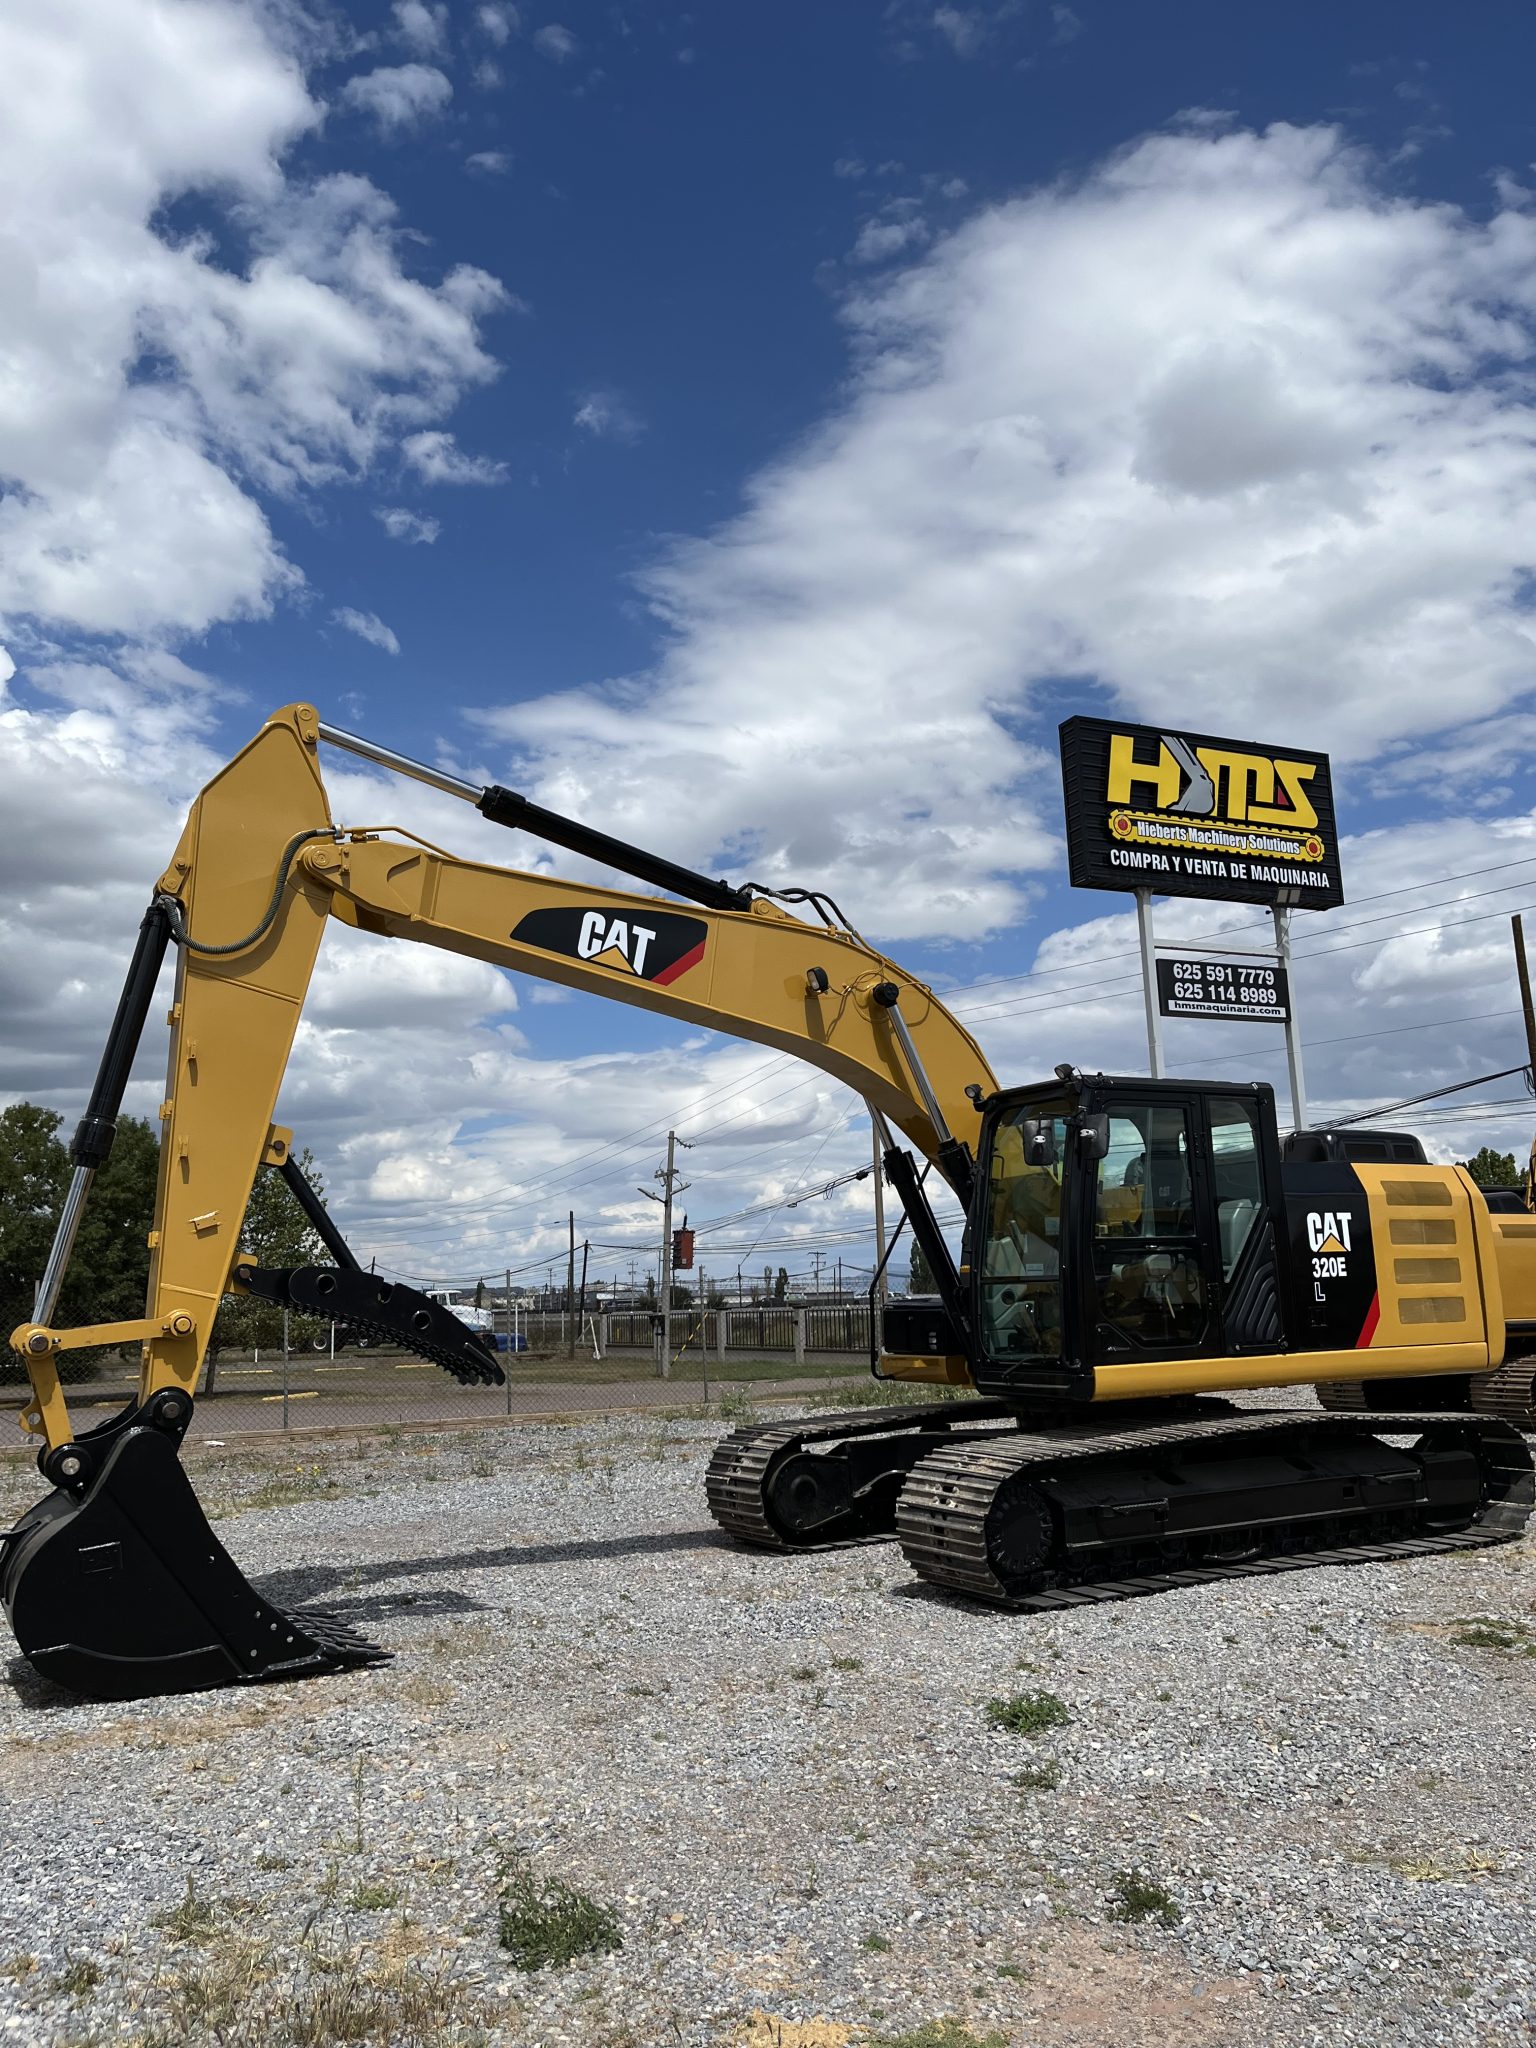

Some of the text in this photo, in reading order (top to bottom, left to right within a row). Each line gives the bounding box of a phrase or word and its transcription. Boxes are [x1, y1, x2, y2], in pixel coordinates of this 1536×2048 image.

[1137, 821, 1300, 855] Hieberts Machinery Solutions
[1110, 849, 1330, 888] COMPRA Y VENTA DE MAQUINARIA
[578, 911, 656, 976] CAT
[1173, 963, 1275, 986] 625 591 7779
[1174, 982, 1277, 1004] 625 114 8989
[1174, 1001, 1281, 1015] hmsmaquinaria.com
[1306, 1212, 1352, 1252] CAT
[1311, 1256, 1348, 1278] 320E
[1314, 1281, 1326, 1302] L
